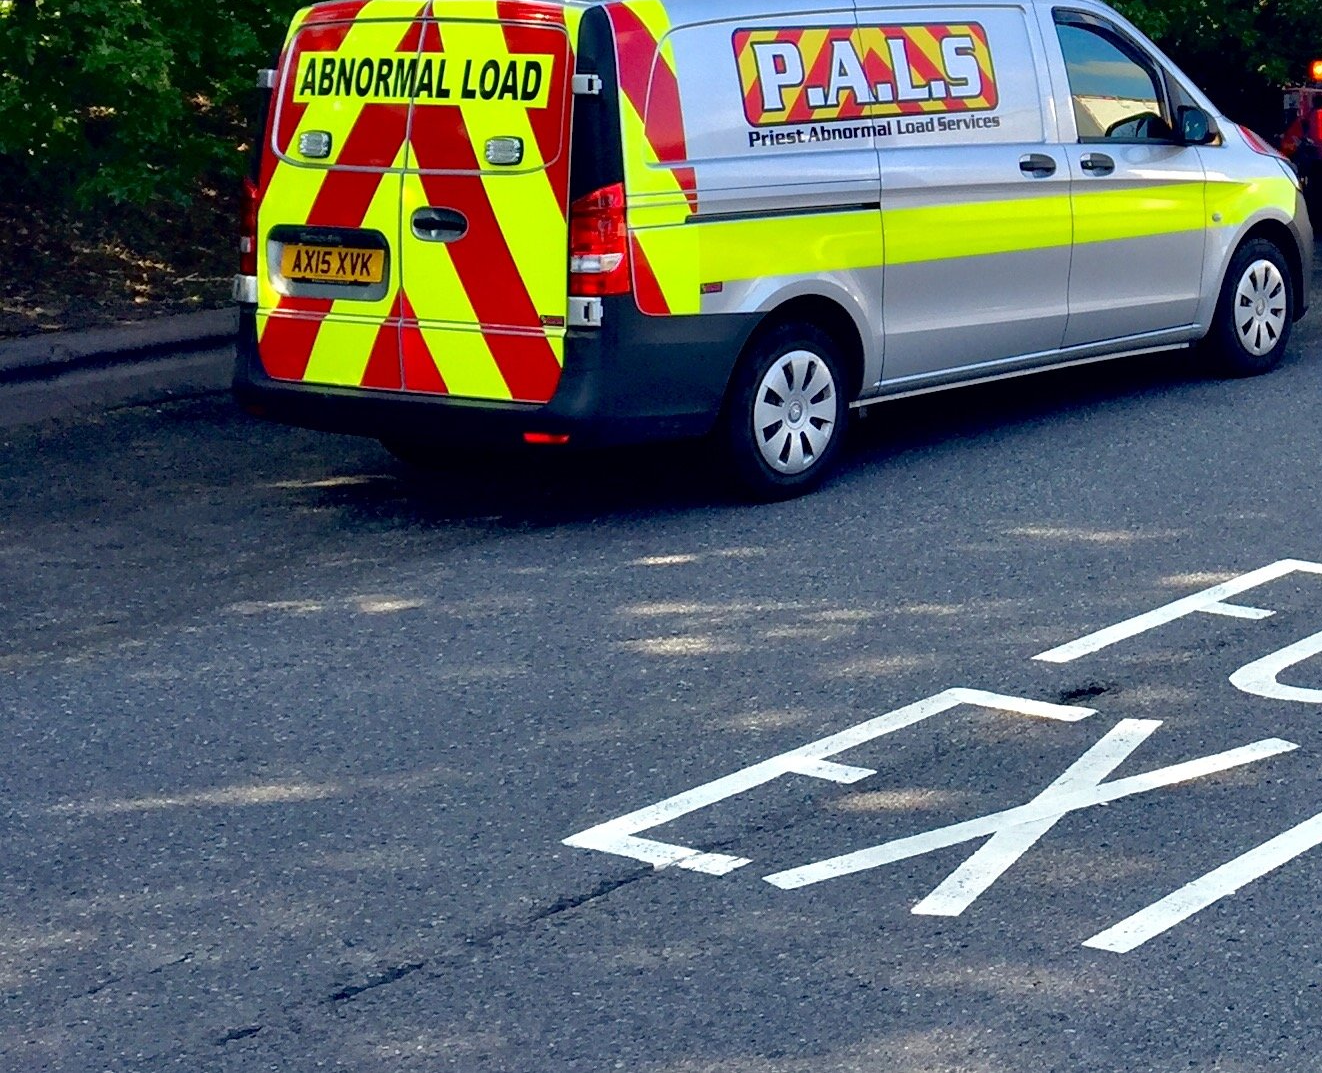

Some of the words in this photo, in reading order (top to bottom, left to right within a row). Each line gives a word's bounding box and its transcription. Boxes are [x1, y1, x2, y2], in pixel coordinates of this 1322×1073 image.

[300, 57, 451, 99] ABNORMAL
[461, 59, 542, 101] LOAD
[748, 130, 804, 148] Priest
[808, 121, 892, 143] Abnormal
[897, 118, 935, 135] Load
[937, 114, 1001, 132] Services
[291, 249, 333, 274] AX15
[335, 251, 373, 277] XVK
